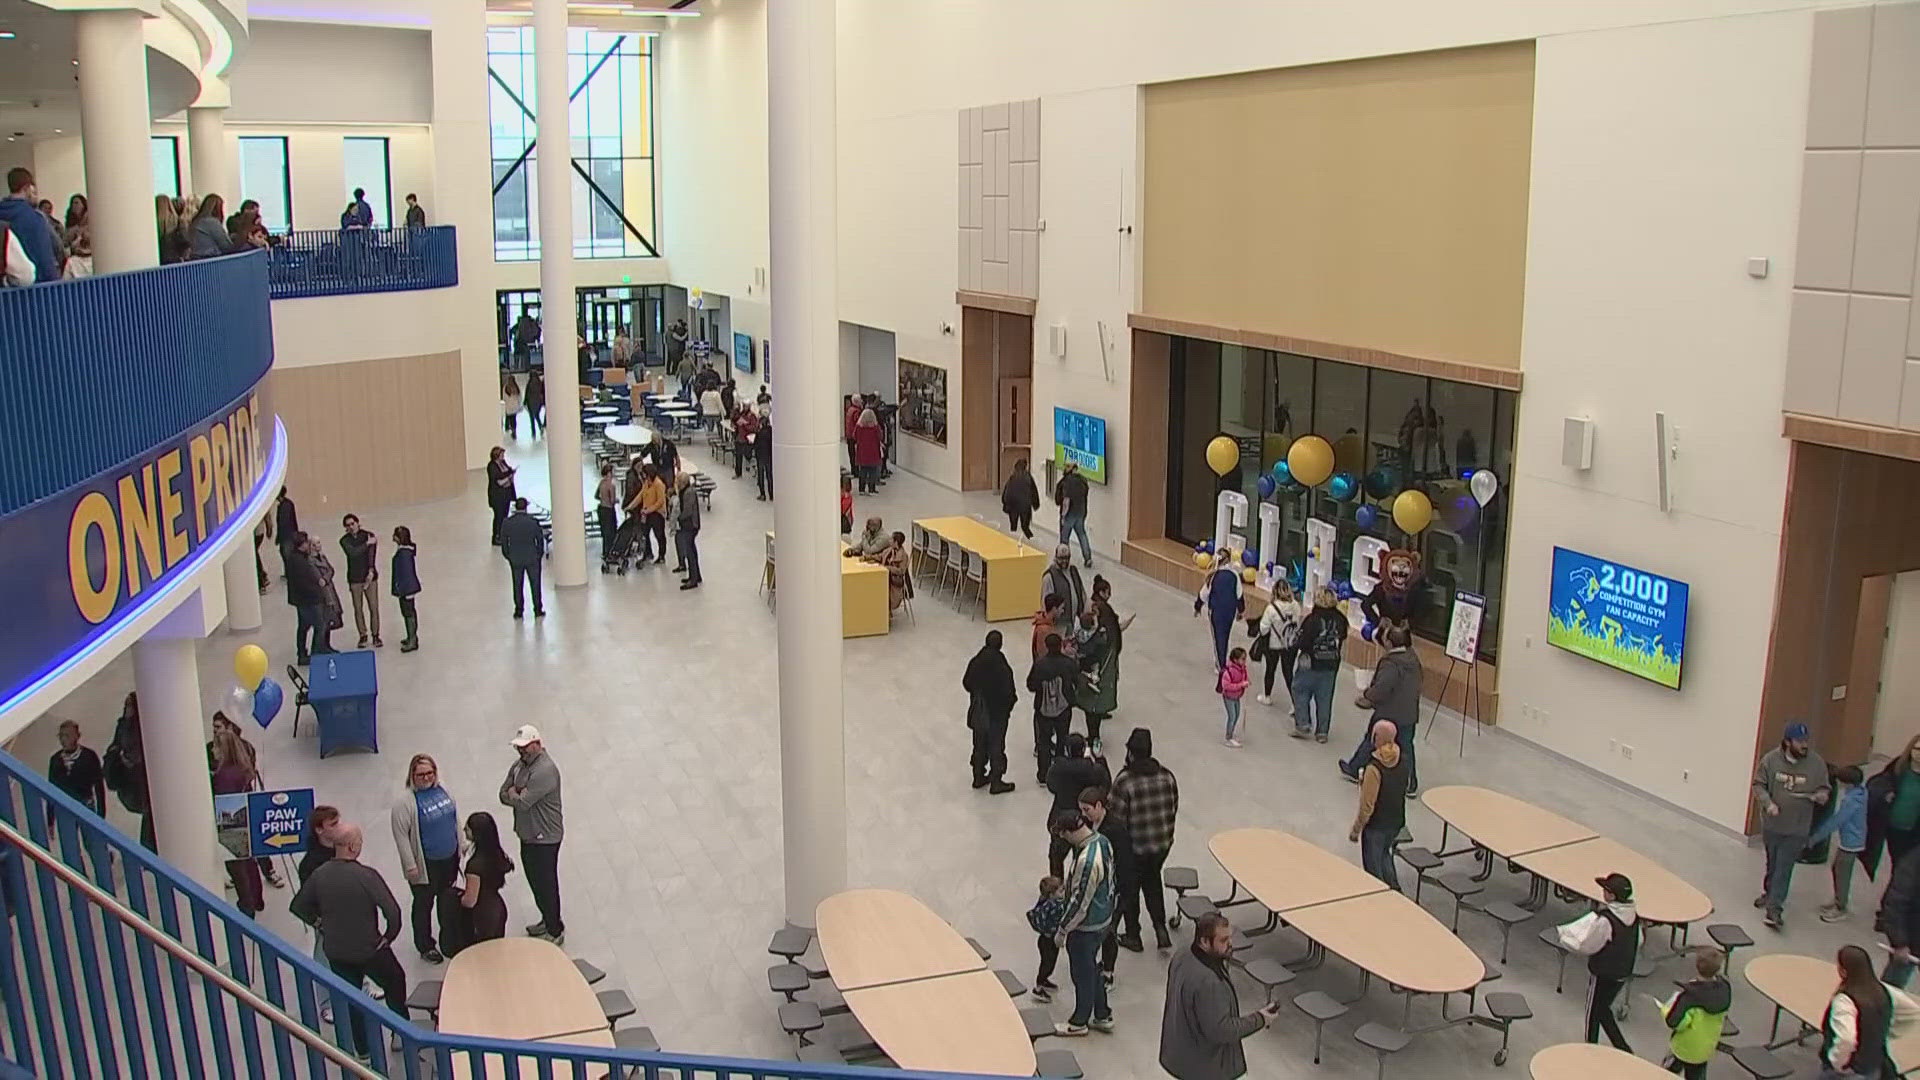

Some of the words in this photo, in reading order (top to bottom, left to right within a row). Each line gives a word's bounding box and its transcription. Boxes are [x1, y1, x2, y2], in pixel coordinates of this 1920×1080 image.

[68, 449, 189, 625] ONE
[190, 392, 264, 545] PRIDE
[1600, 564, 1669, 606] 2,000
[1599, 591, 1647, 613] COMPETITION
[1648, 605, 1667, 620] GYM
[1605, 604, 1621, 617] FAN
[1622, 608, 1660, 628] CAPACITY
[261, 819, 304, 834] PRINT
[265, 807, 297, 821] PAW
